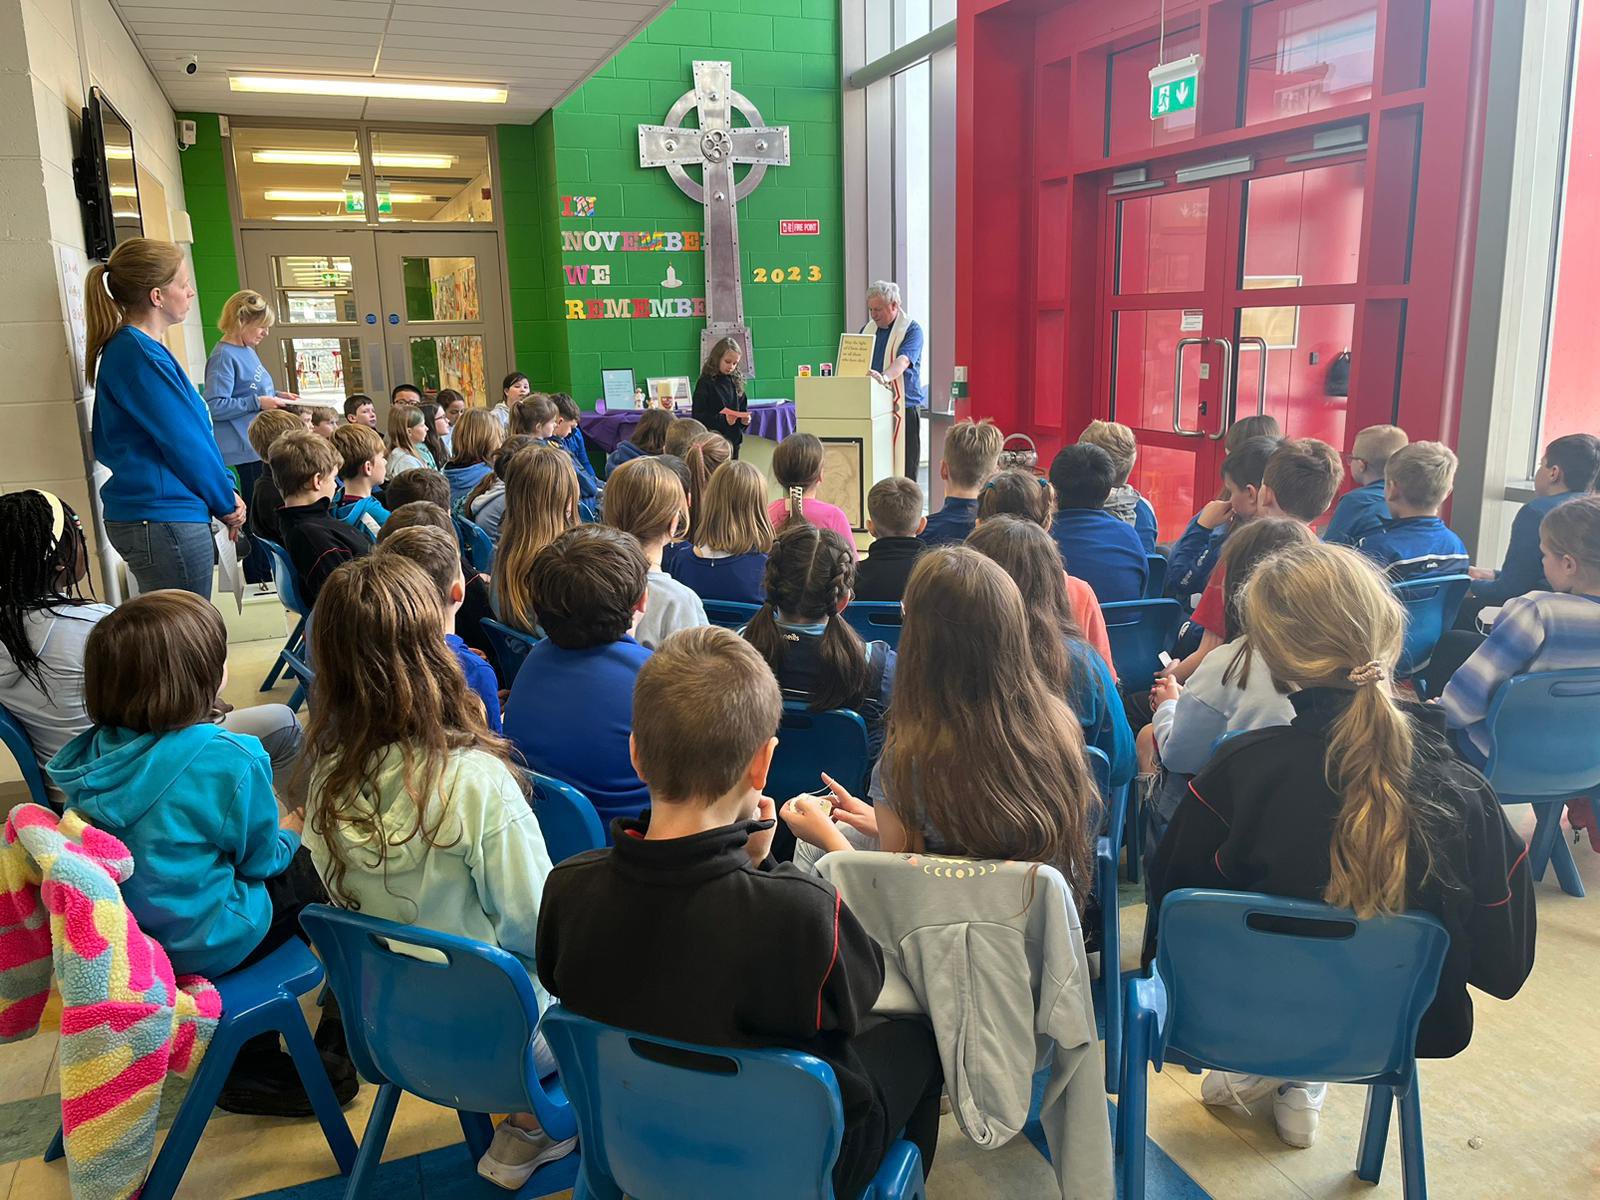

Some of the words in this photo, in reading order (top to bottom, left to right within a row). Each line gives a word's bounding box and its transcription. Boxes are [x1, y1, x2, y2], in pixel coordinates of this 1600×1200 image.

[561, 196, 597, 217] IN
[794, 223, 803, 232] FIRE
[804, 223, 817, 232] POINT
[561, 230, 705, 251] NOVEMBE
[563, 264, 611, 285] WE
[753, 265, 822, 283] 2023
